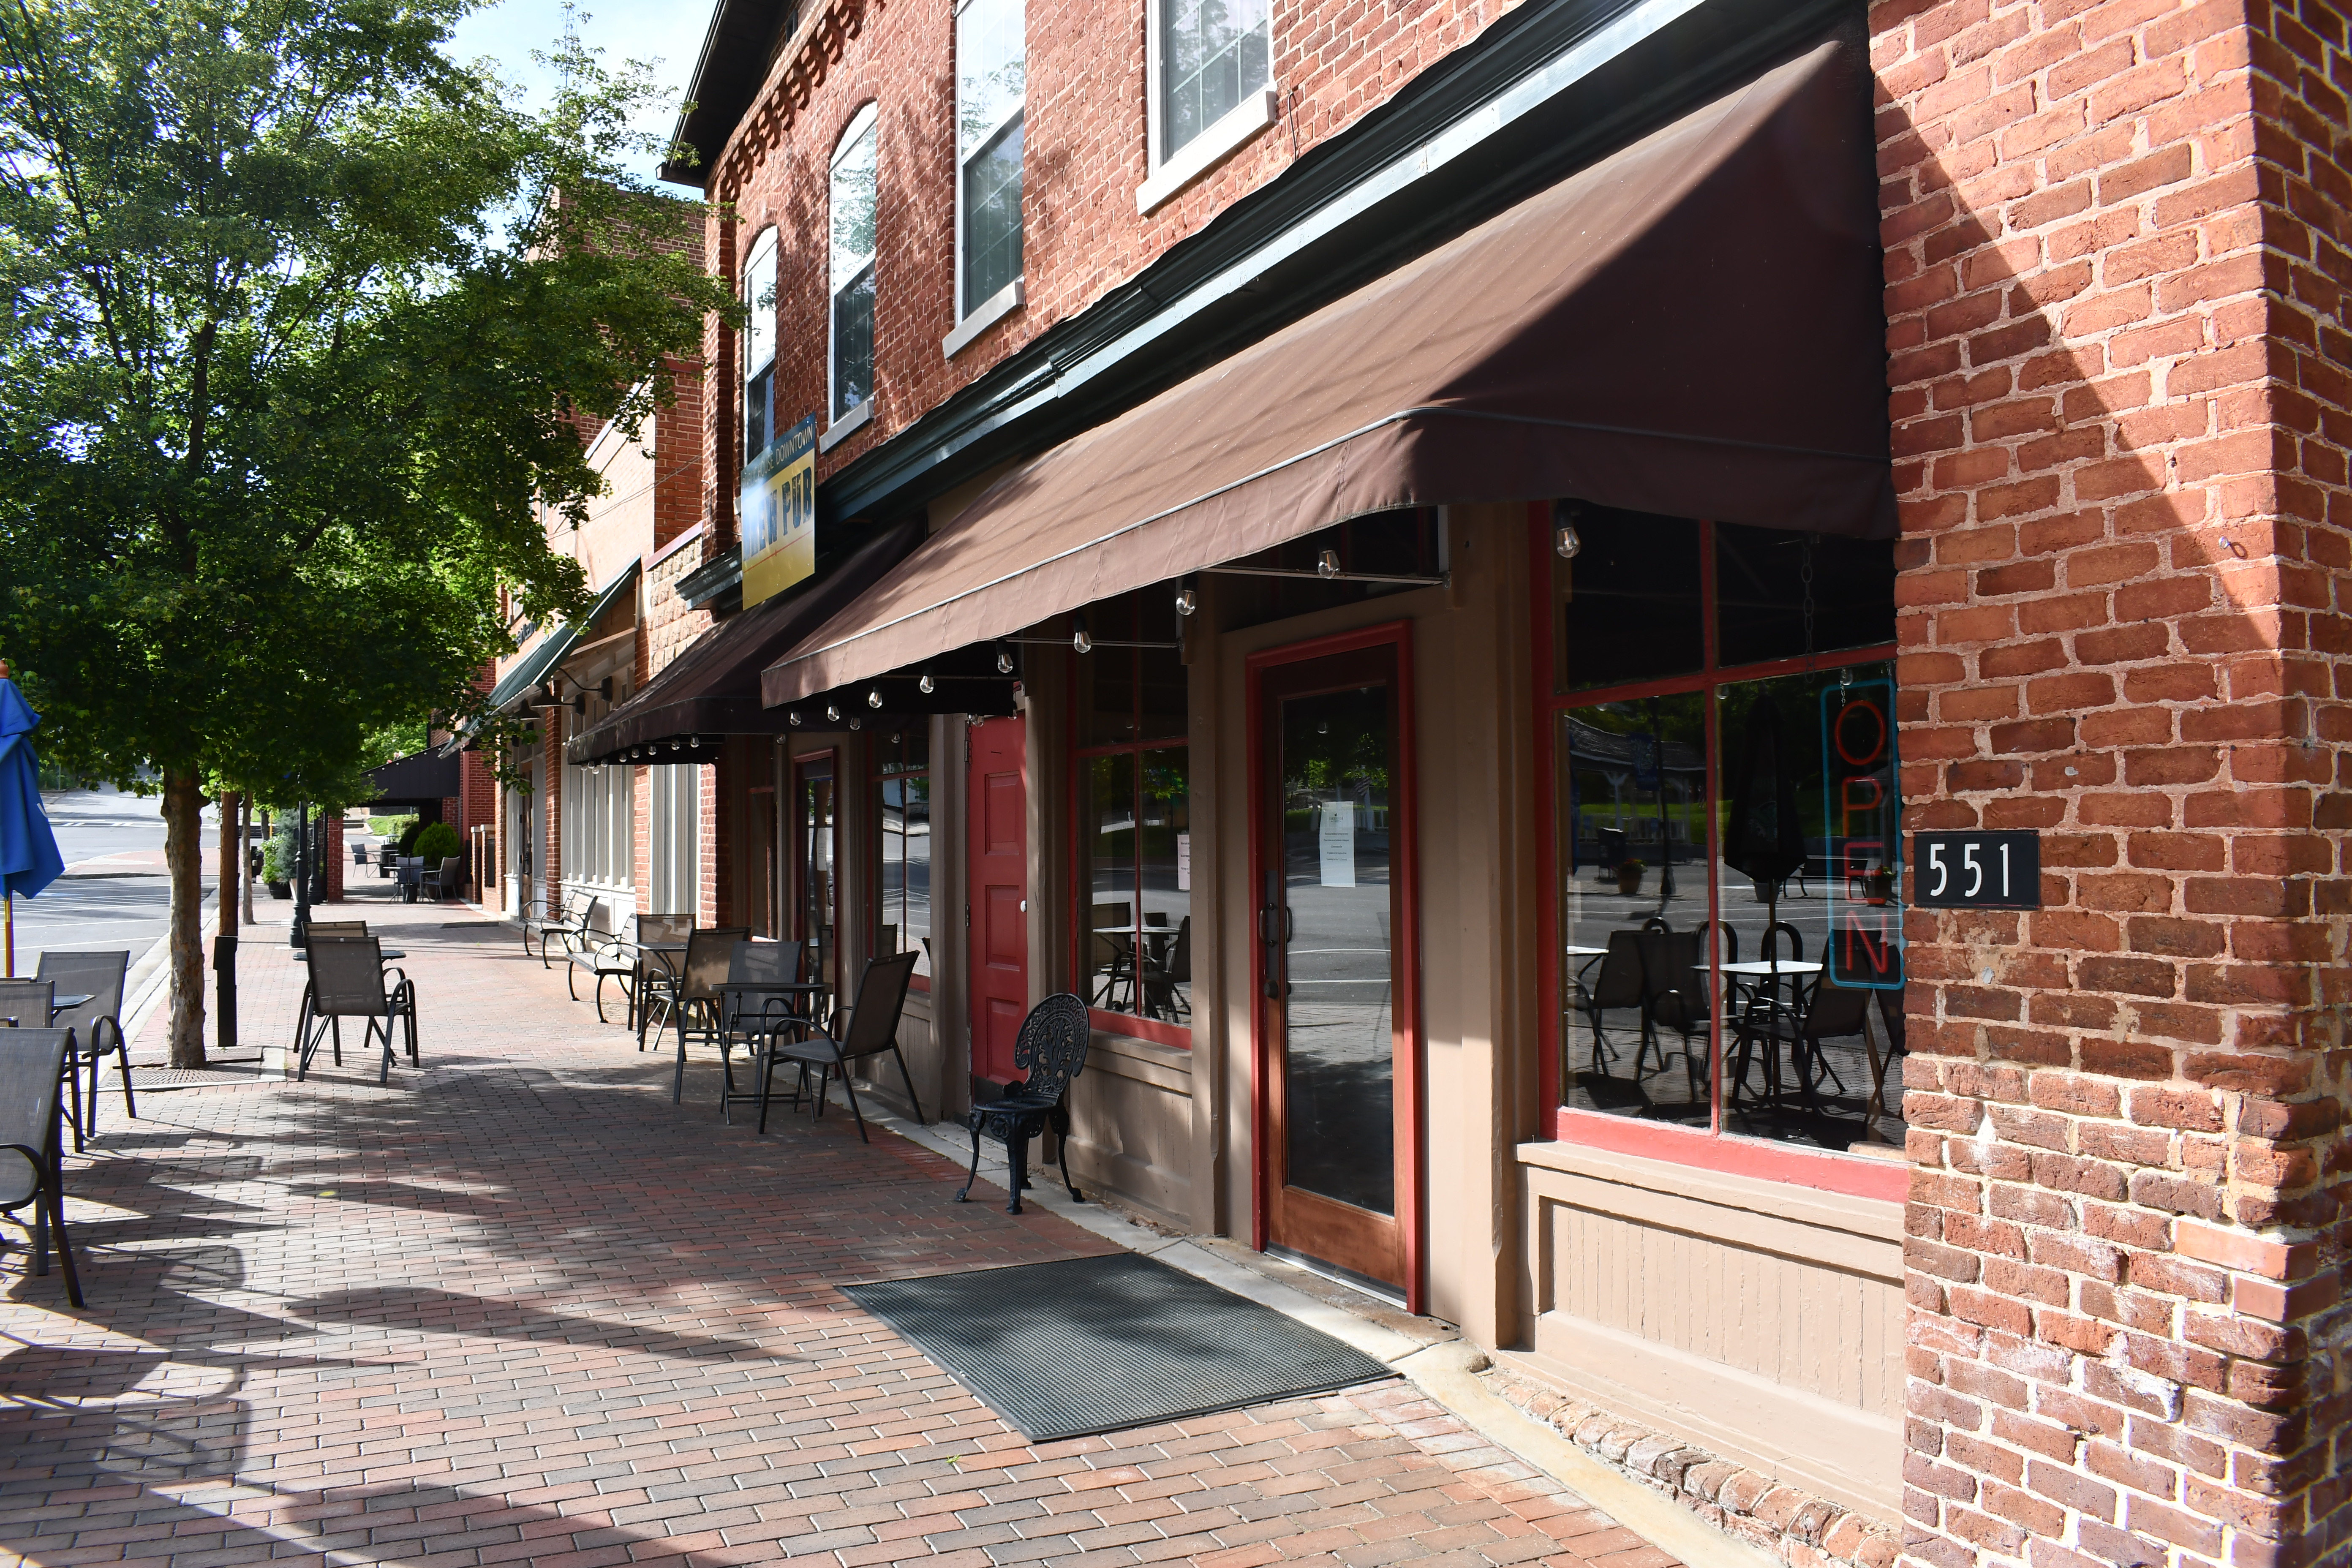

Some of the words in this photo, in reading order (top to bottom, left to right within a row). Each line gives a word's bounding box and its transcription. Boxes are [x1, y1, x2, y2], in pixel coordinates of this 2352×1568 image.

[776, 424, 813, 465] DOWNTOWN
[782, 466, 812, 536] PUB
[1835, 700, 1888, 973] OPEN
[1930, 843, 2009, 897] 551
